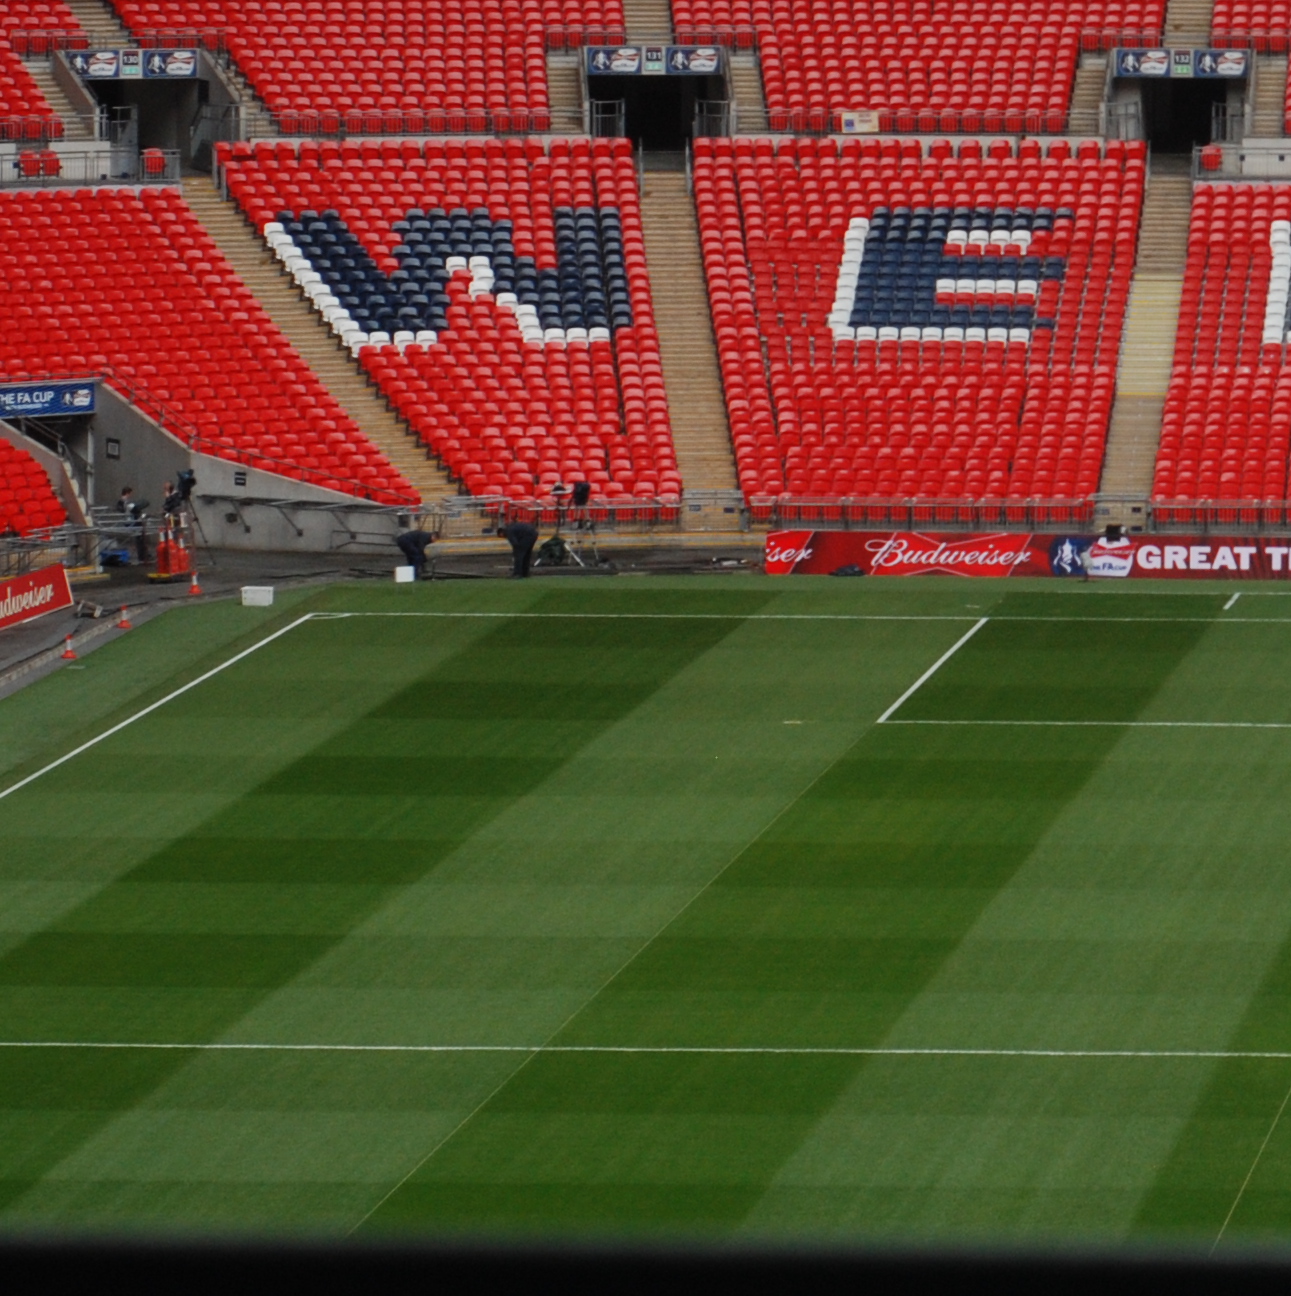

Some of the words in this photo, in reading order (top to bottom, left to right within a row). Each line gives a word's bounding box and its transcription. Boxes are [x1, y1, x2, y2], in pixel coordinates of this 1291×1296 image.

[123, 56, 138, 64] 130
[646, 52, 661, 60] 131
[17, 392, 31, 403] FA
[33, 391, 54, 402] CUP
[865, 539, 1031, 569] Budweiser
[1137, 546, 1257, 571] GREAT
